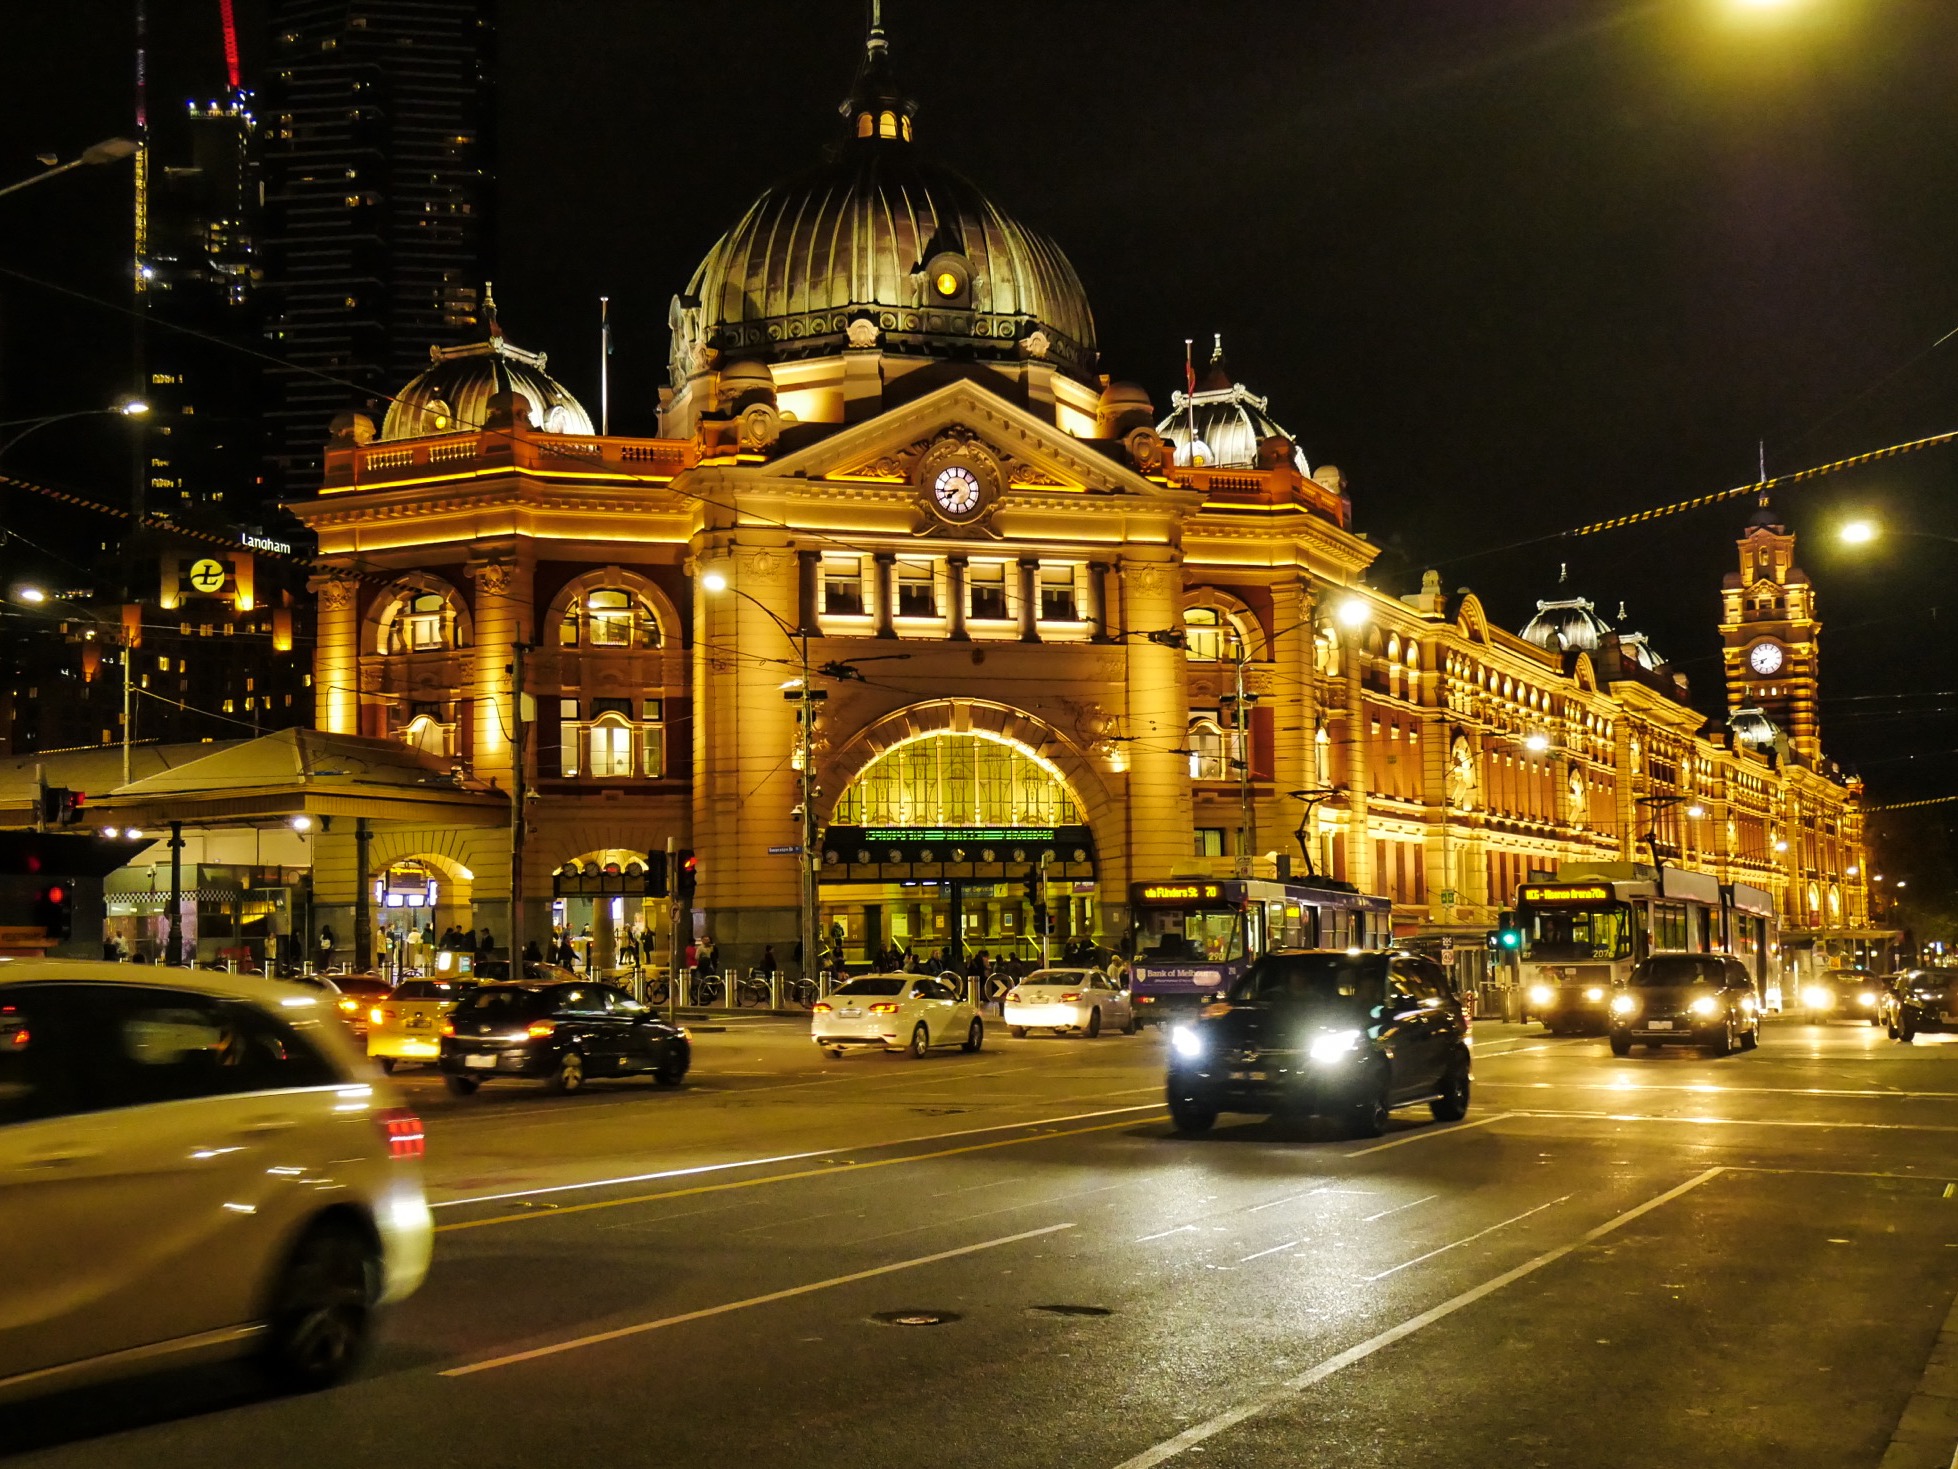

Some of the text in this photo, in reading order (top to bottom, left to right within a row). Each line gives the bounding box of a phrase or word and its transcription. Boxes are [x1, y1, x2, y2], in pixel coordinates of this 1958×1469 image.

[241, 533, 291, 554] Langham
[1145, 886, 1217, 898] via Flinders St 70
[1208, 952, 1224, 961] 290
[1593, 950, 1614, 958] 2076
[1147, 969, 1167, 977] Bank
[1168, 969, 1176, 977] of
